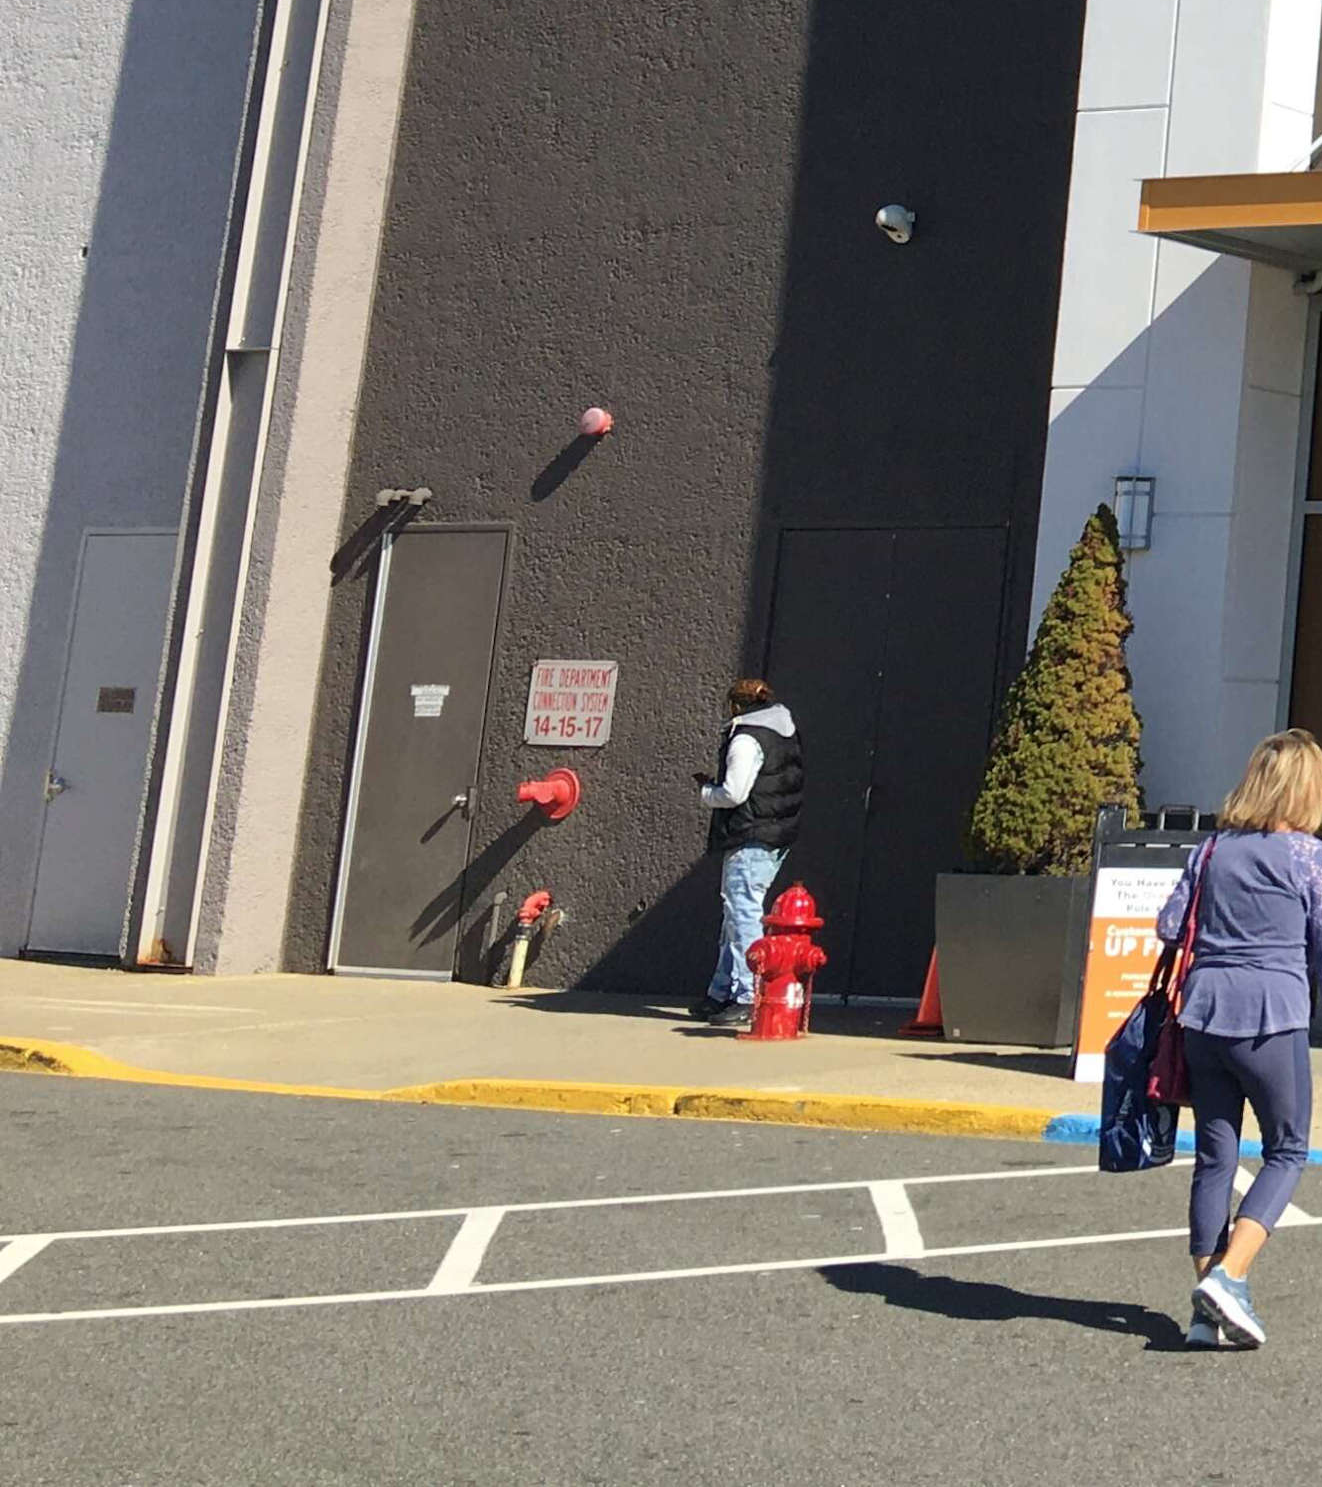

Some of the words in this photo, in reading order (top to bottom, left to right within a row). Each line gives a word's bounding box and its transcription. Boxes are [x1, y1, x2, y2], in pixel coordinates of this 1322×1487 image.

[536, 668, 555, 687] FIRE
[559, 668, 611, 688] DEPARTMENT
[581, 692, 609, 712] SYSTEM
[533, 715, 604, 738] 14-15-17
[1104, 936, 1137, 957] UP
